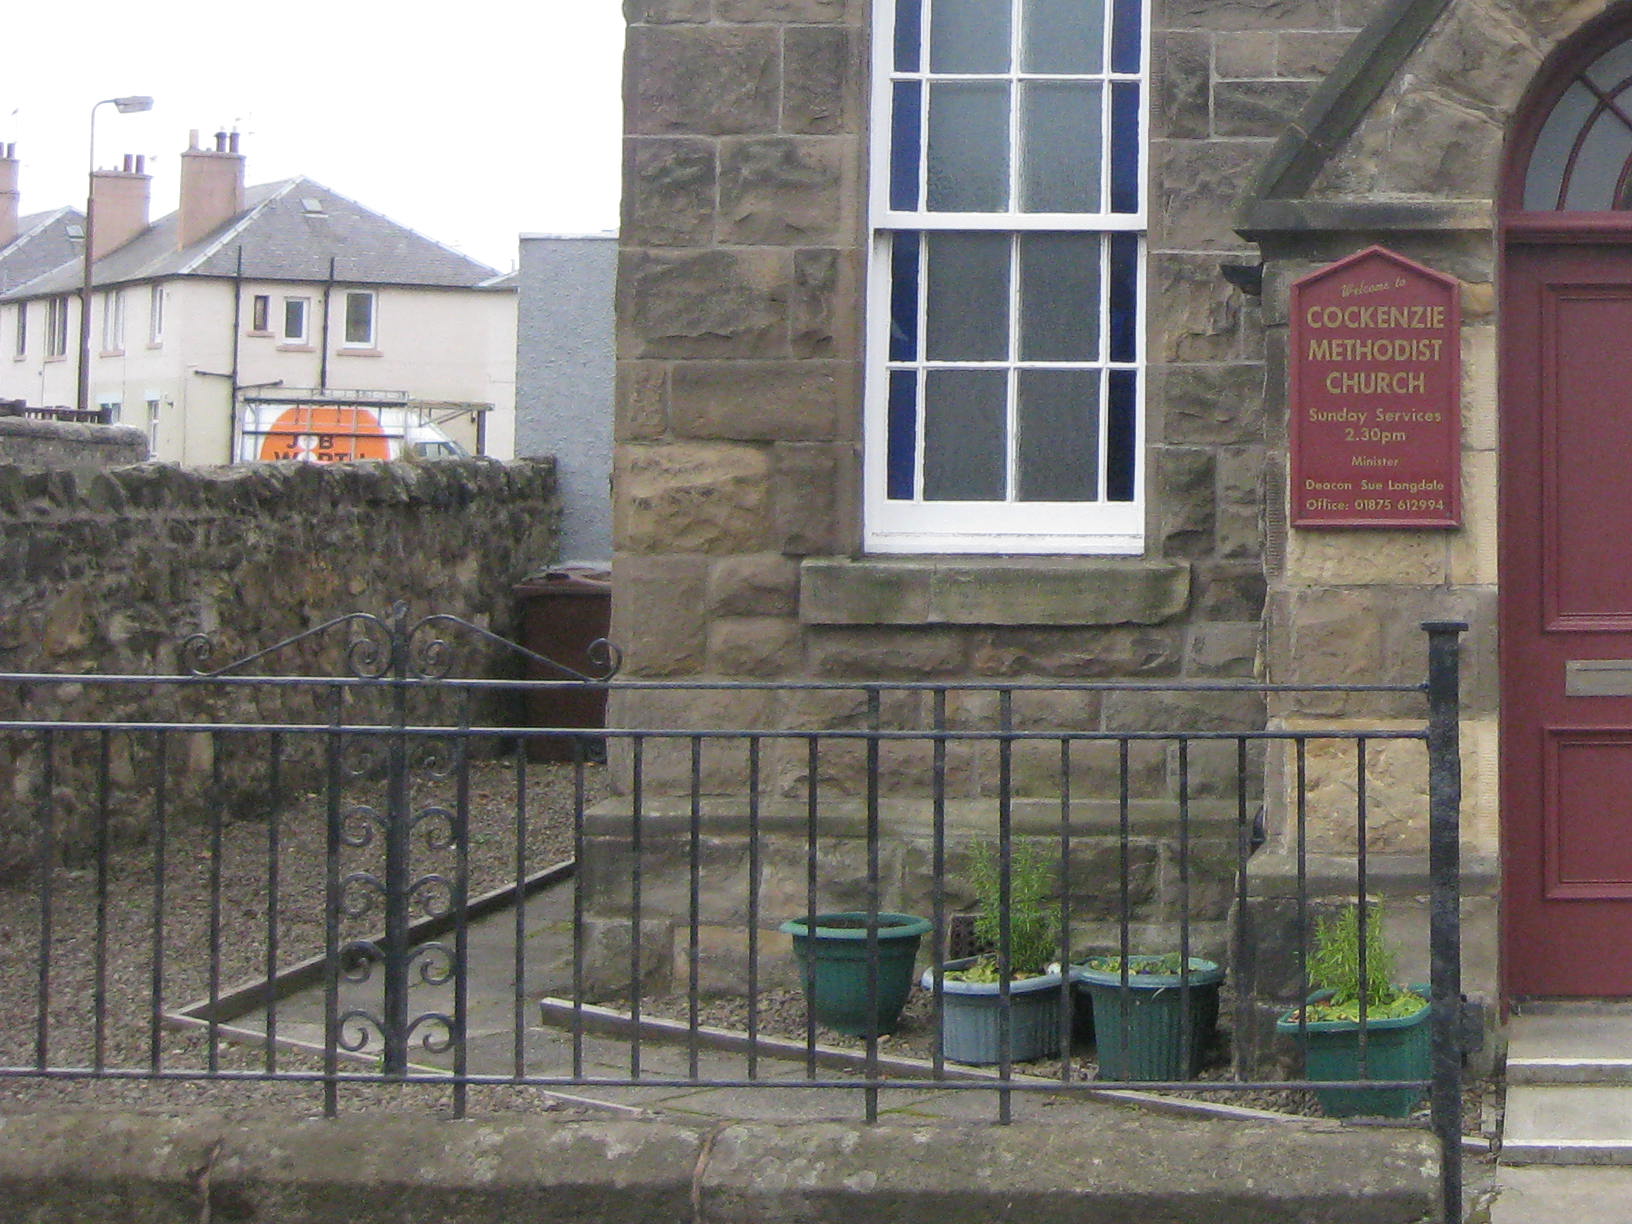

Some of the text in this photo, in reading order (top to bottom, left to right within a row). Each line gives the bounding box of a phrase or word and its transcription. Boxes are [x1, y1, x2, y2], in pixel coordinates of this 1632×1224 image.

[1306, 306, 1444, 328] COCKENZIE
[1308, 339, 1443, 361] METHODIST
[1326, 372, 1425, 394] CHURCH
[1309, 408, 1441, 425] Sunday Services
[1345, 428, 1406, 445] 2.30pm
[1351, 456, 1399, 466] Minister
[1305, 479, 1444, 493] Deacon Sue Langdale
[1306, 498, 1444, 510] Office: 01875 612994
